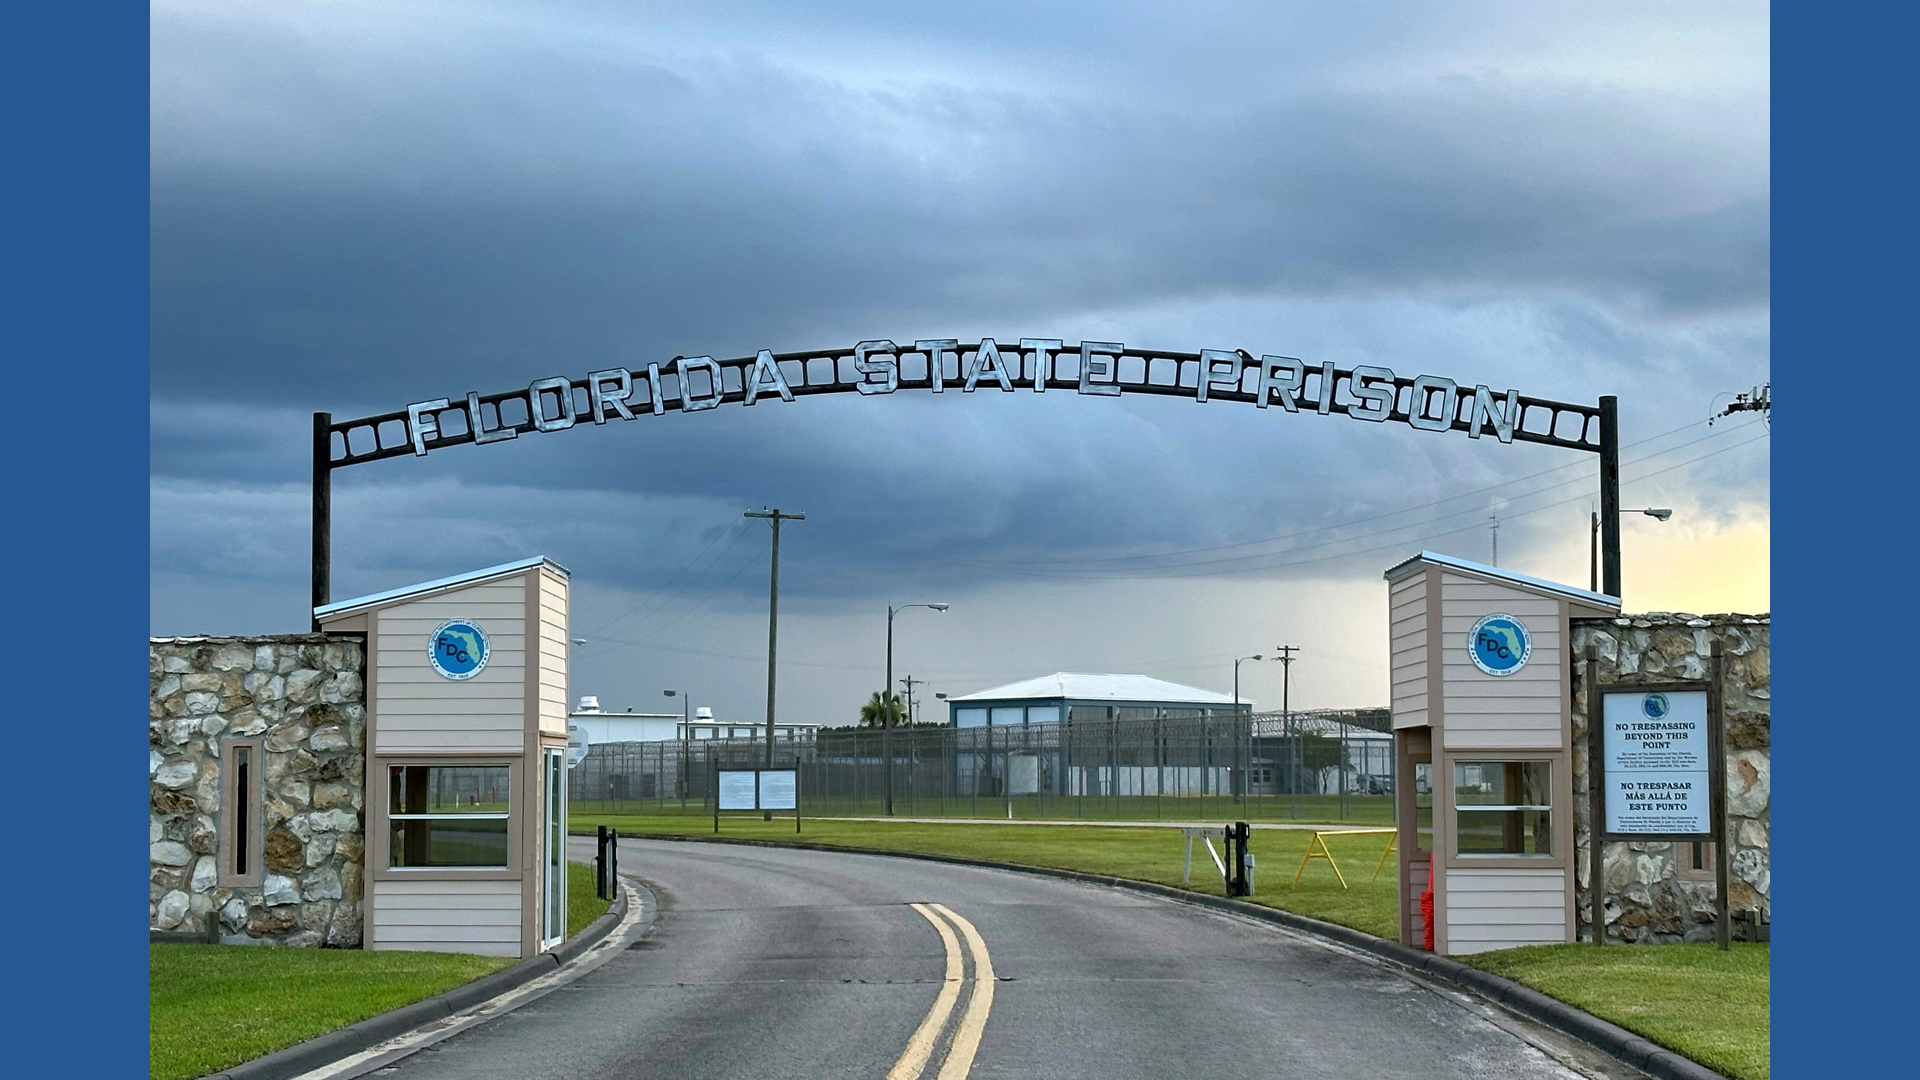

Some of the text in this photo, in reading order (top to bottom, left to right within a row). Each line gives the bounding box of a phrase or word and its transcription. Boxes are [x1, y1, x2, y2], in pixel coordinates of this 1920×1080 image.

[406, 338, 1519, 457] FLORIDA STATE PRISON
[438, 637, 468, 663] FDC
[1478, 633, 1509, 659] FDC
[1615, 722, 1696, 731] NO TRESPASSING
[1625, 732, 1688, 740] BEYOND THIS
[1642, 741, 1671, 749] POINT
[1621, 782, 1692, 790] NO TRESPASAR
[1625, 791, 1688, 800] MÁS ALLÁ DE
[1629, 803, 1688, 811] ESTE PUNTO
